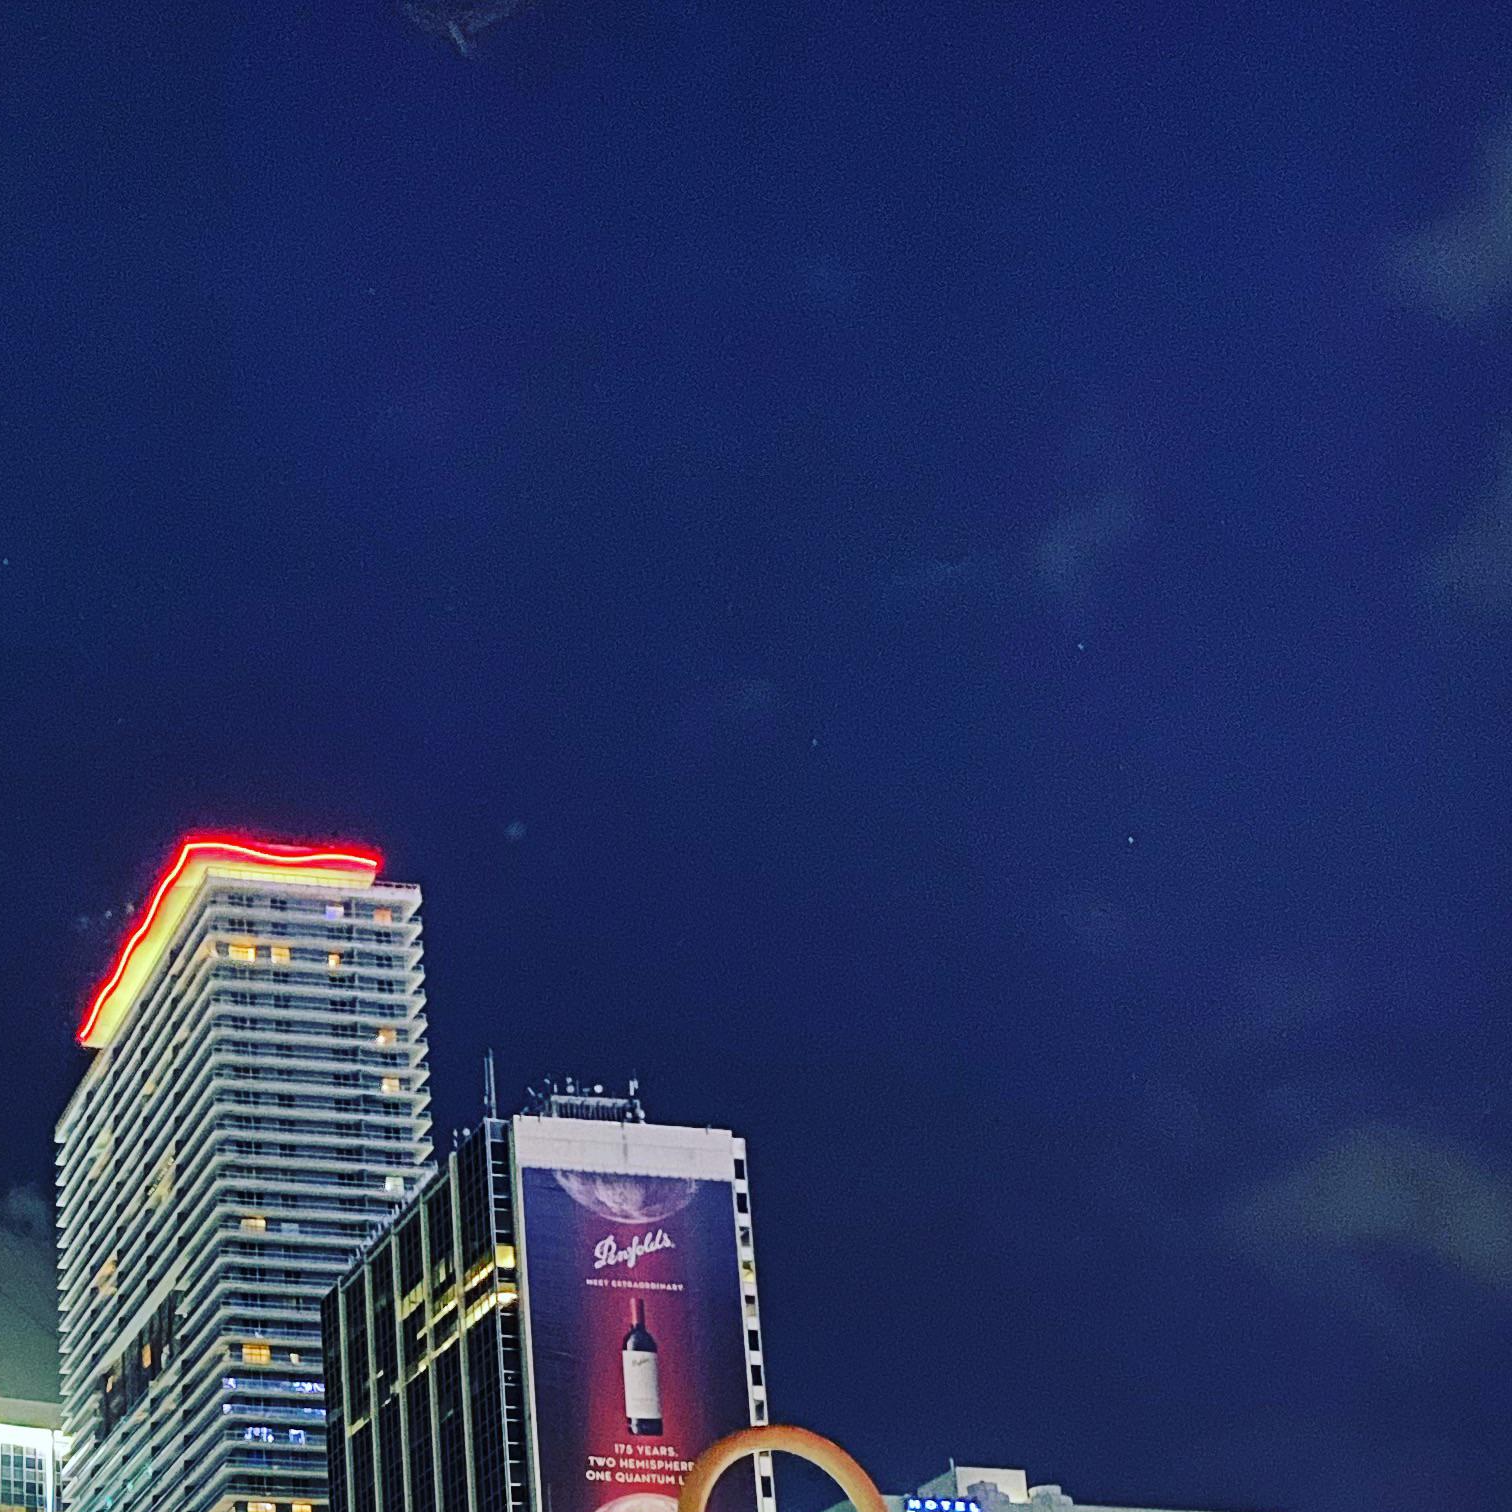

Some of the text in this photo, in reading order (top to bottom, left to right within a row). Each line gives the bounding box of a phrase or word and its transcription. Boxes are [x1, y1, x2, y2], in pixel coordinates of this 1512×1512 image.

[593, 1228, 672, 1269] Penfolds
[614, 1443, 679, 1457] 175 YEARS.
[588, 1455, 695, 1472] TWO HEMISPHERE
[585, 1469, 612, 1482] ONE
[615, 1472, 676, 1484] QUANTUM
[908, 1499, 981, 1512] HOTEL
